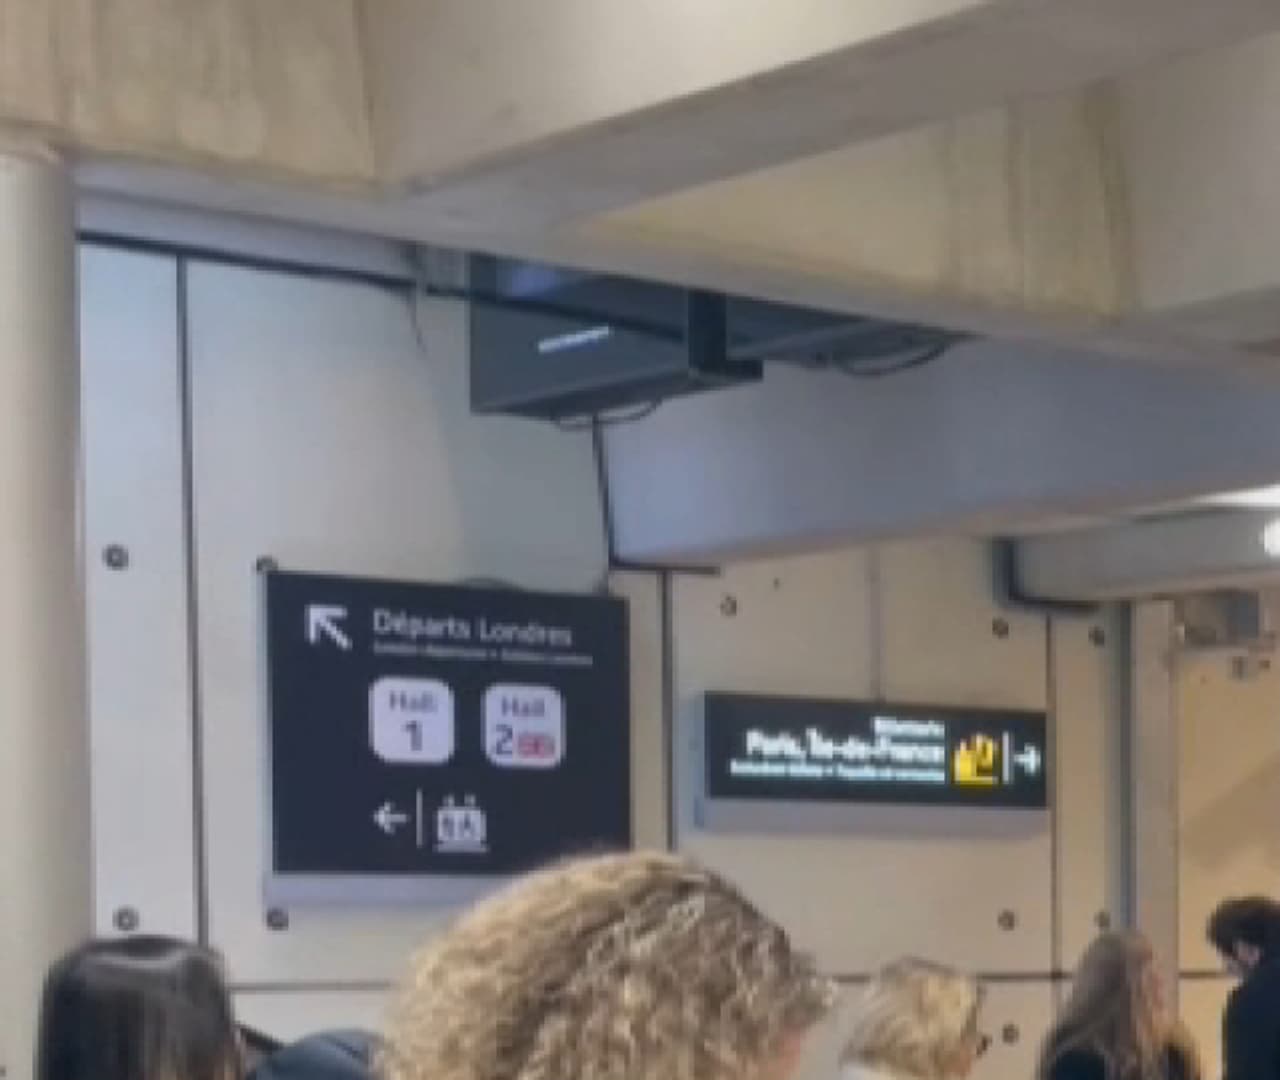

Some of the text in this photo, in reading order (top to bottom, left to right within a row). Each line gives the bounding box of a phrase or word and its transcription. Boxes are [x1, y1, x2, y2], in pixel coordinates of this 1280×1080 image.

[373, 607, 573, 647] Départs Londres
[389, 690, 436, 714] Hall
[502, 696, 545, 718] Hall
[405, 720, 423, 751] 1
[495, 723, 513, 755] 2
